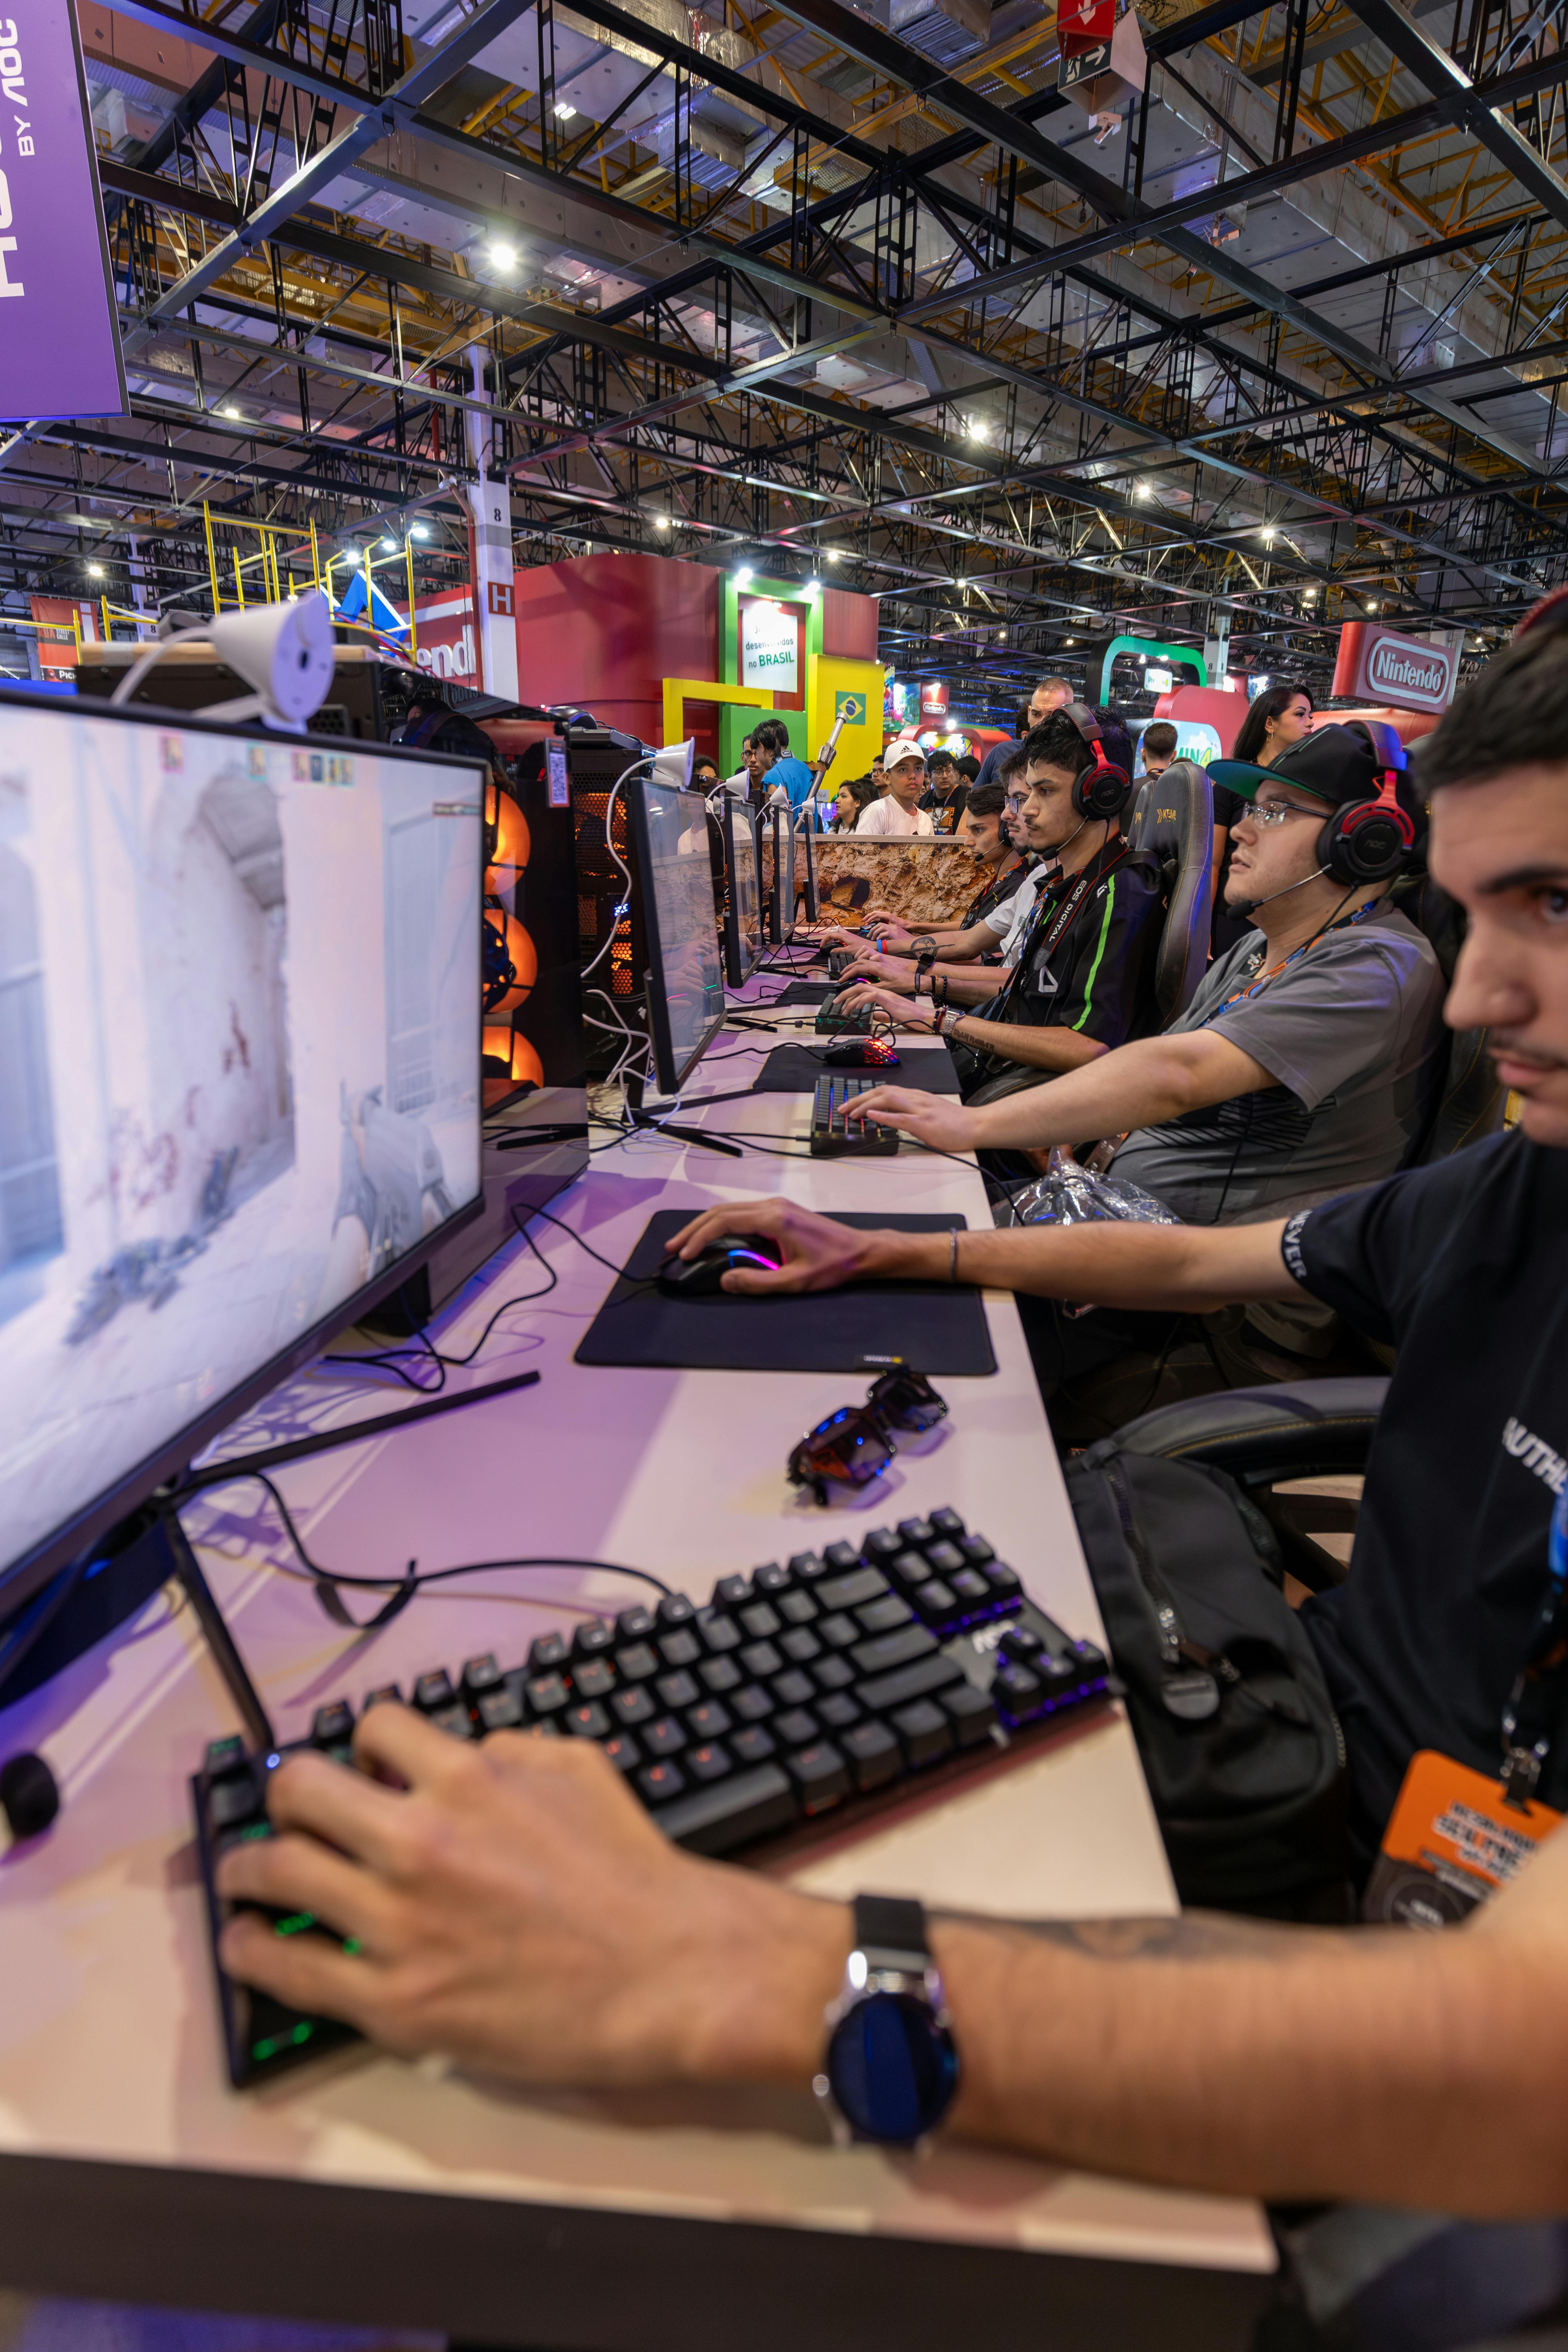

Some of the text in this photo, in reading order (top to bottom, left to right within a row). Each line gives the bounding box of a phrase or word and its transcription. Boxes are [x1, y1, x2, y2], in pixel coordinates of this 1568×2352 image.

[14, 115, 35, 156] BY
[494, 508, 501, 522] 8
[492, 584, 511, 614] H
[416, 624, 476, 678] end
[746, 638, 794, 650] desenidos
[759, 651, 795, 667] BRASIL
[1049, 880, 1087, 942] EOS DIGITAL
